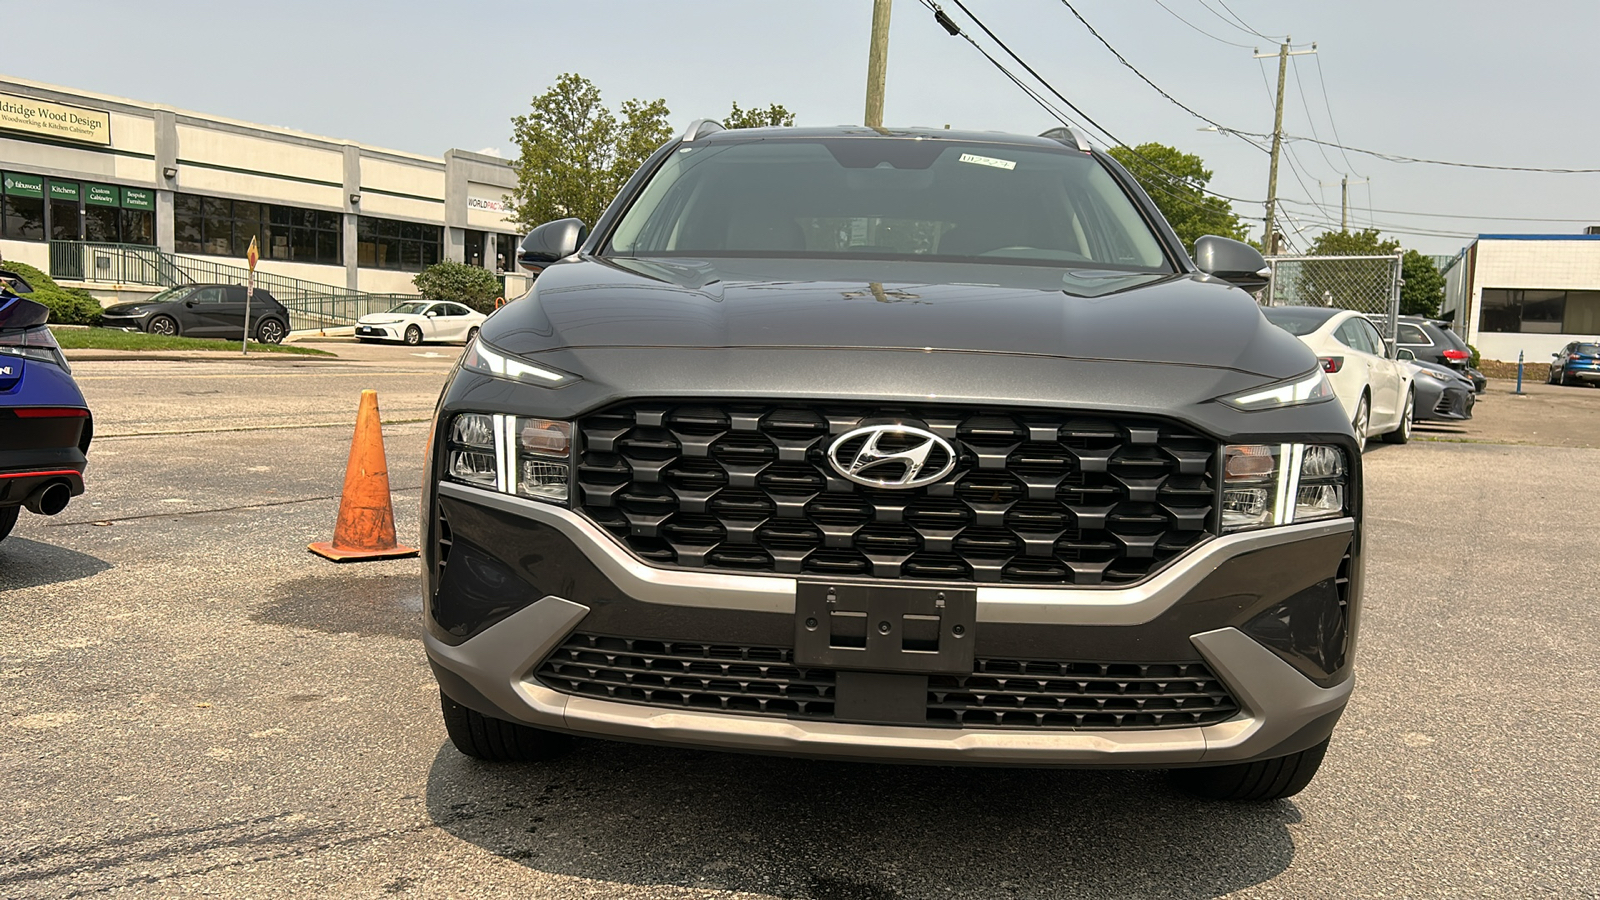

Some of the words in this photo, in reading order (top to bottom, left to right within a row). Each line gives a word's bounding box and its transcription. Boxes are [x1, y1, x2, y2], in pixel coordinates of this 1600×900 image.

[38, 107, 67, 122] Wood
[69, 113, 102, 129] Design
[1, 114, 42, 128] Woodworking
[48, 122, 69, 131] Kitchen
[69, 125, 95, 137] Cabinetry
[15, 180, 42, 191] fabuwood
[51, 185, 76, 194] Kitchens
[91, 186, 110, 194] Custom
[90, 194, 113, 203] Cabinetry
[127, 191, 146, 199] Bespoke
[126, 197, 148, 206] Furniture
